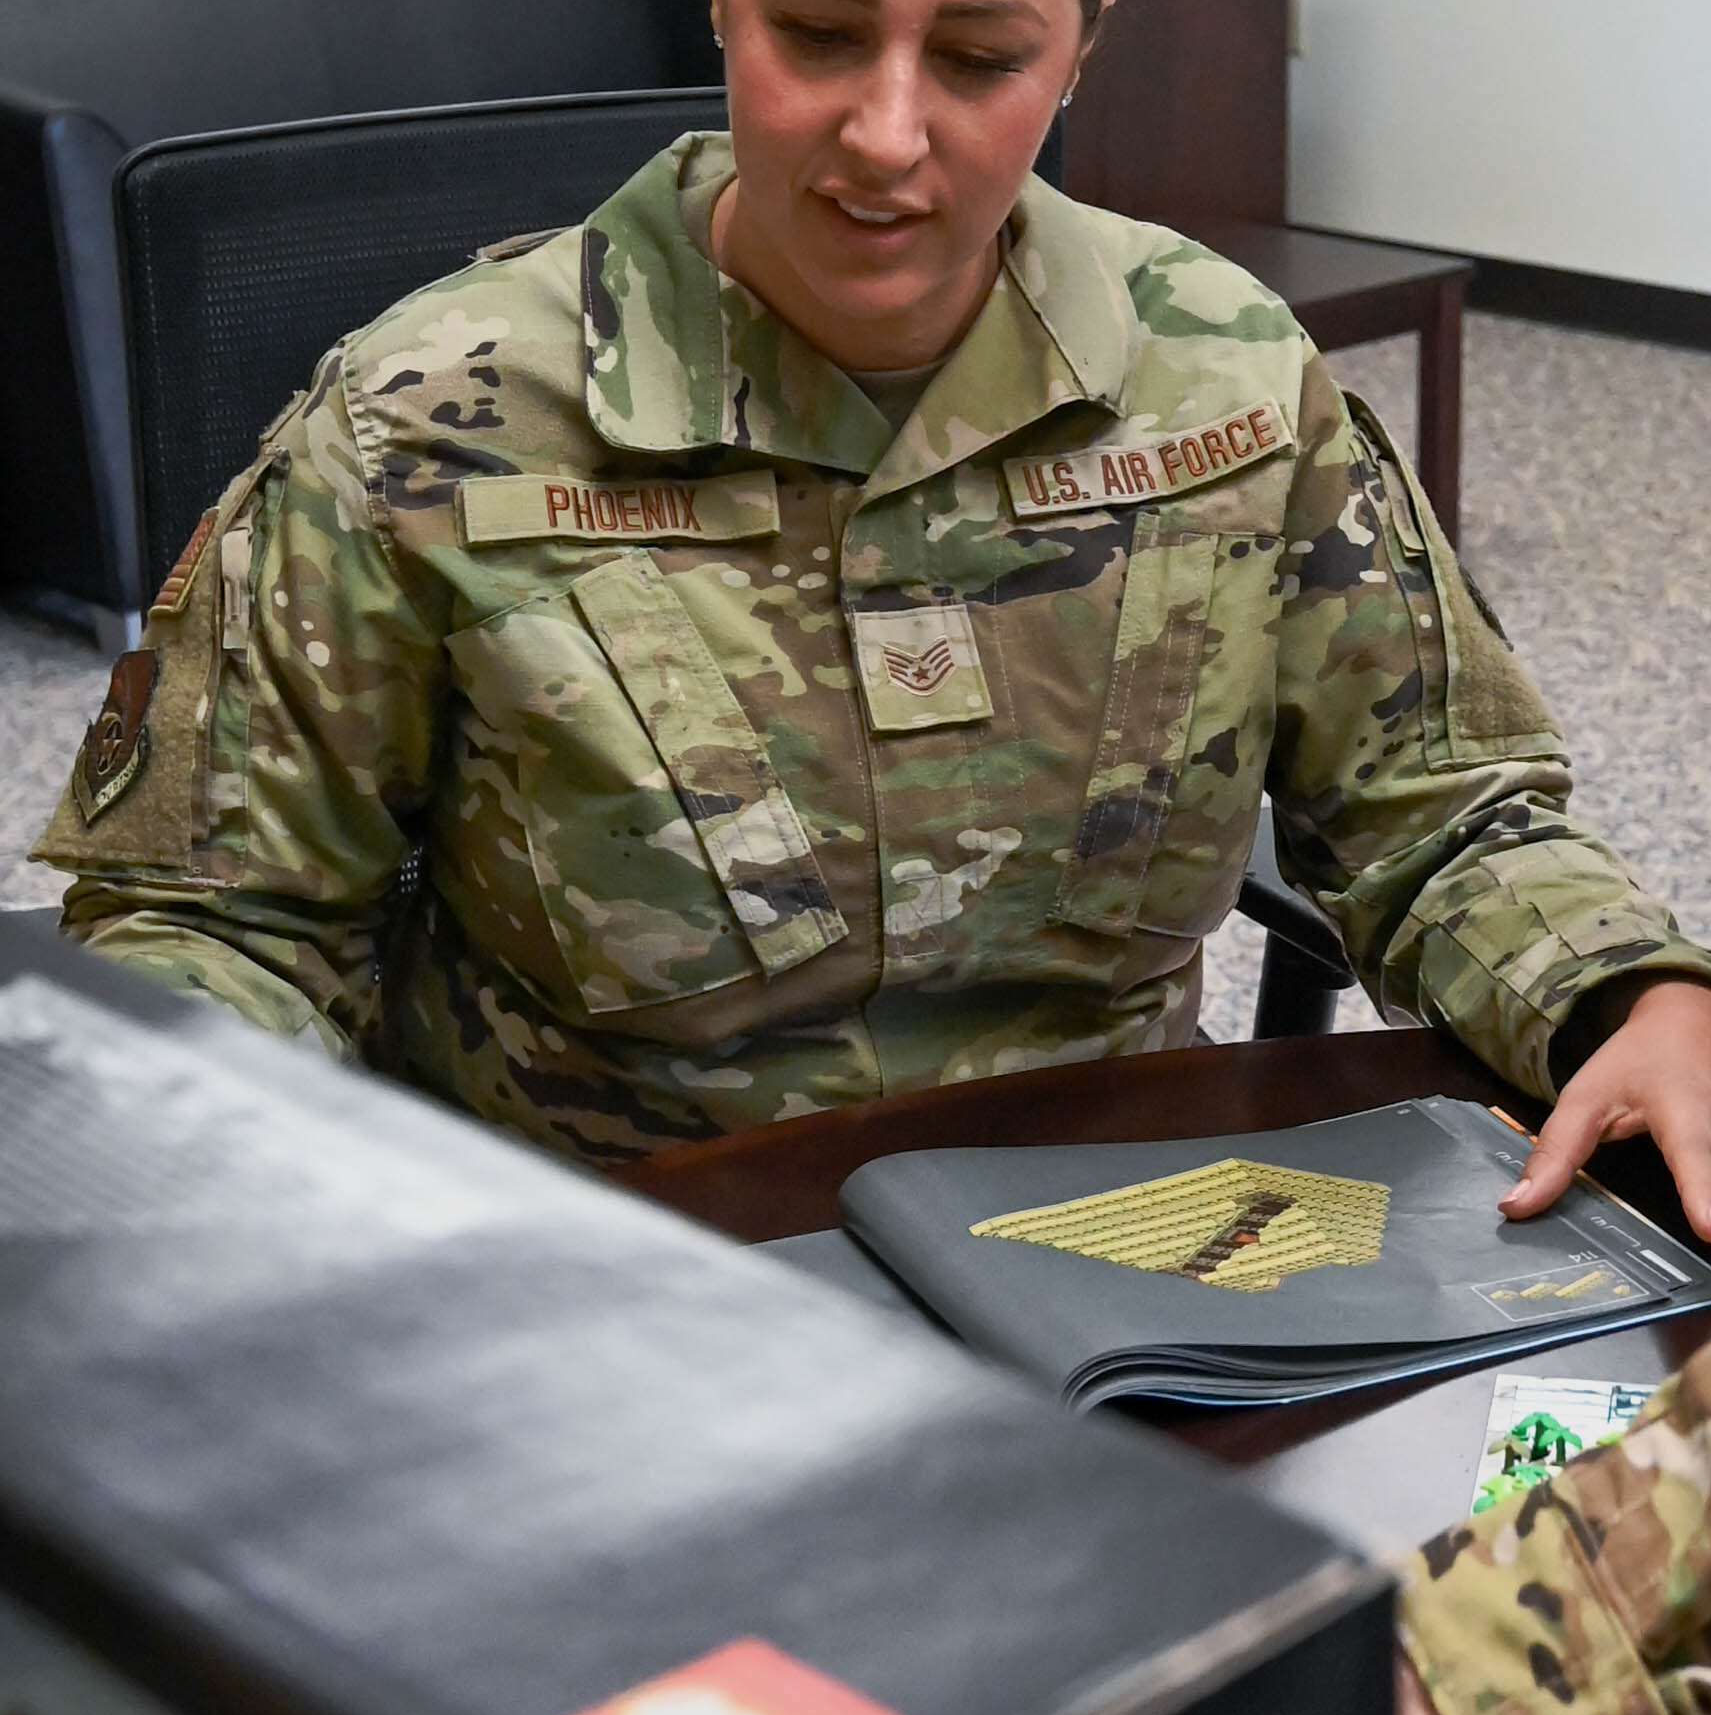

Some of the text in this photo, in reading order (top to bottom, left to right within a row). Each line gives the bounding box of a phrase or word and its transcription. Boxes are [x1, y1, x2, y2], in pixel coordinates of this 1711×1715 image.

[1022, 409, 1278, 506] U.S. AIR FORCE
[544, 484, 702, 532] PHOENIX
